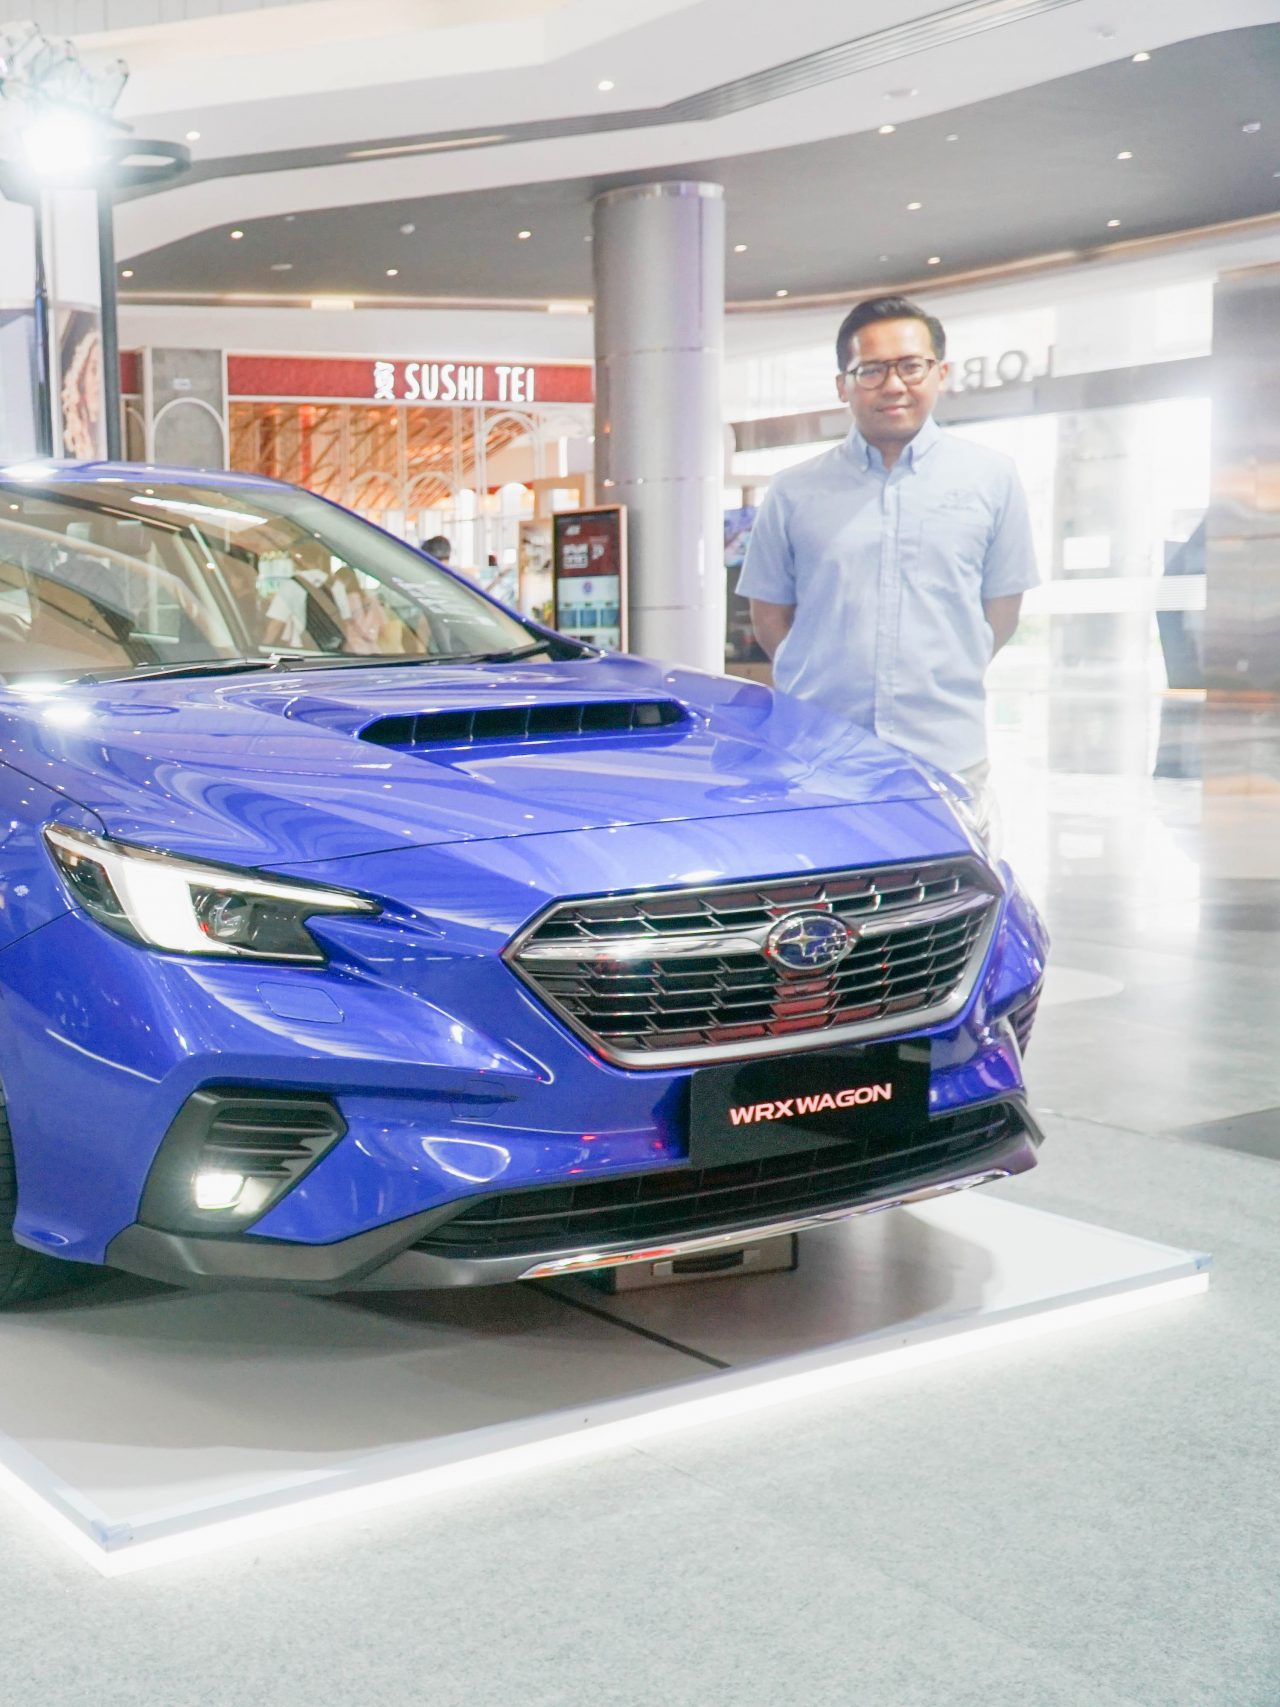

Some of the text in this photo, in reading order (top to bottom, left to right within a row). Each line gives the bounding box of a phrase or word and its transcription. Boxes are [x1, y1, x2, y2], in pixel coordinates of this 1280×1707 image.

[404, 363, 484, 401] SUSHI
[495, 366, 535, 402] TEI
[730, 1083, 893, 1126] WRX WAGON
